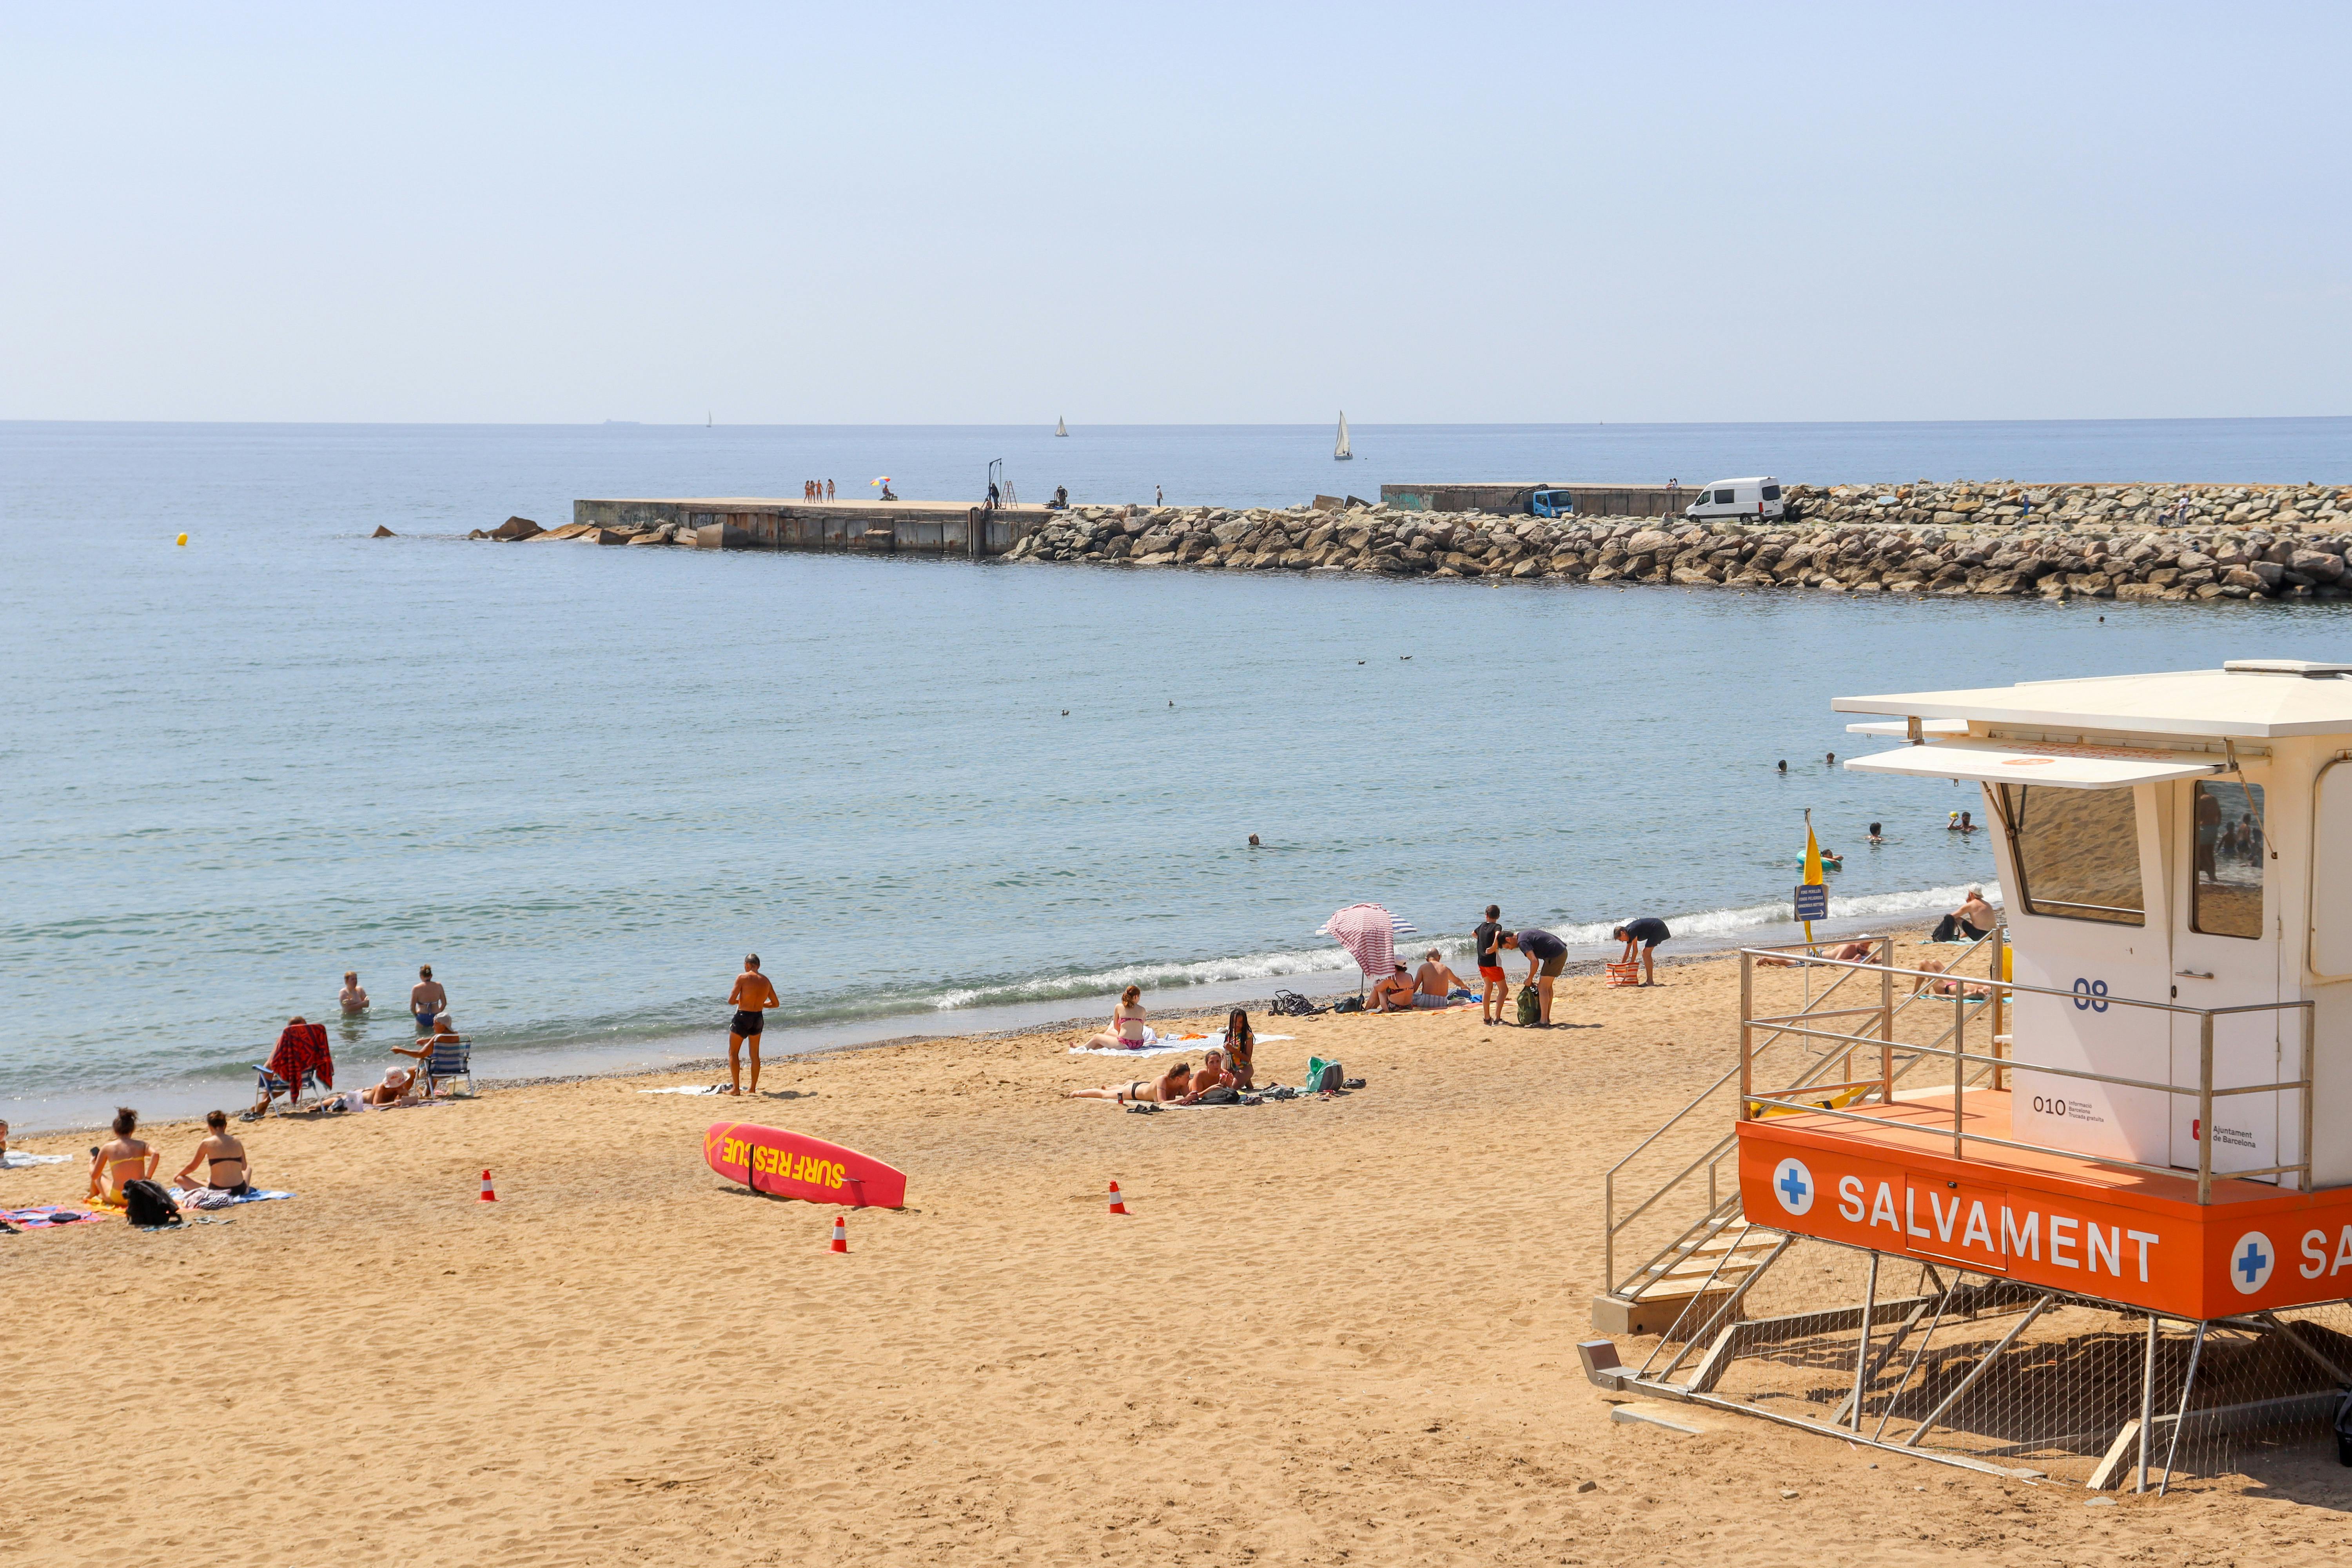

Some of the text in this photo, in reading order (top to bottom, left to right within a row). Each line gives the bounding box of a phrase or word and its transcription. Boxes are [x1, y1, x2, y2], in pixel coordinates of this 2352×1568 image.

[2074, 978, 2109, 1013] 08
[2034, 1096, 2066, 1116] 010
[2069, 1100, 2092, 1109] Informació
[2213, 1125, 2252, 1138] Ajuntament
[2223, 1136, 2256, 1148] Barcelona
[722, 1137, 845, 1189] SURF RESCUE
[1838, 1175, 2160, 1283] SALVAMENT
